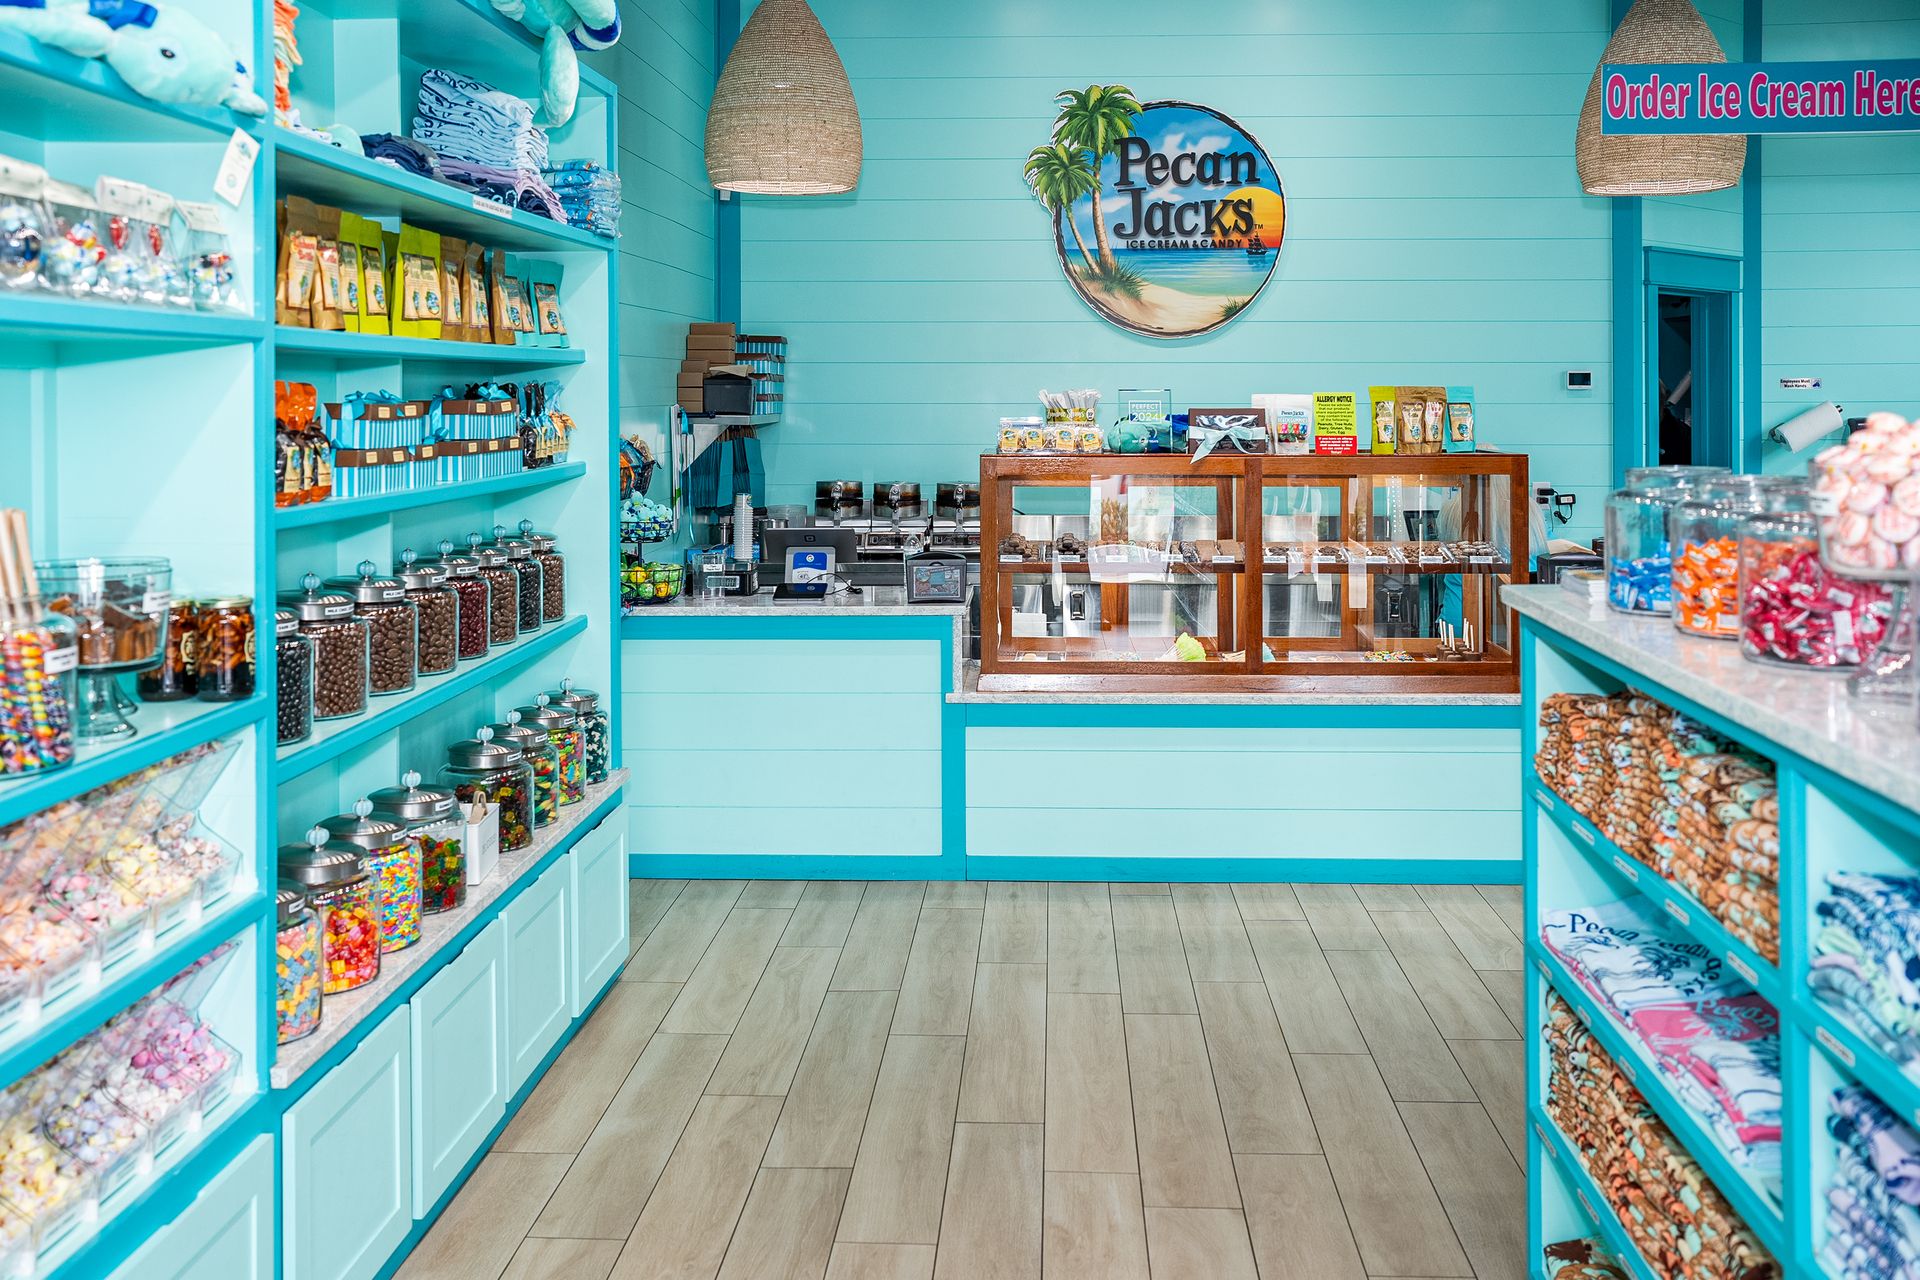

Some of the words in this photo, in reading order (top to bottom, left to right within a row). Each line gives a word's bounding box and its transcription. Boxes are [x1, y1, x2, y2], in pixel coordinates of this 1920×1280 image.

[1606, 73, 1691, 119] Order
[1698, 73, 1742, 119] Ice
[1748, 71, 1846, 119] Cream
[1853, 70, 1920, 118] Here
[1114, 136, 1261, 186] Pecan
[1113, 187, 1255, 238] Jacks
[1126, 239, 1145, 248] ICE
[1147, 239, 1189, 248] CREAM
[1191, 239, 1199, 248] &
[1200, 239, 1242, 248] CANDY
